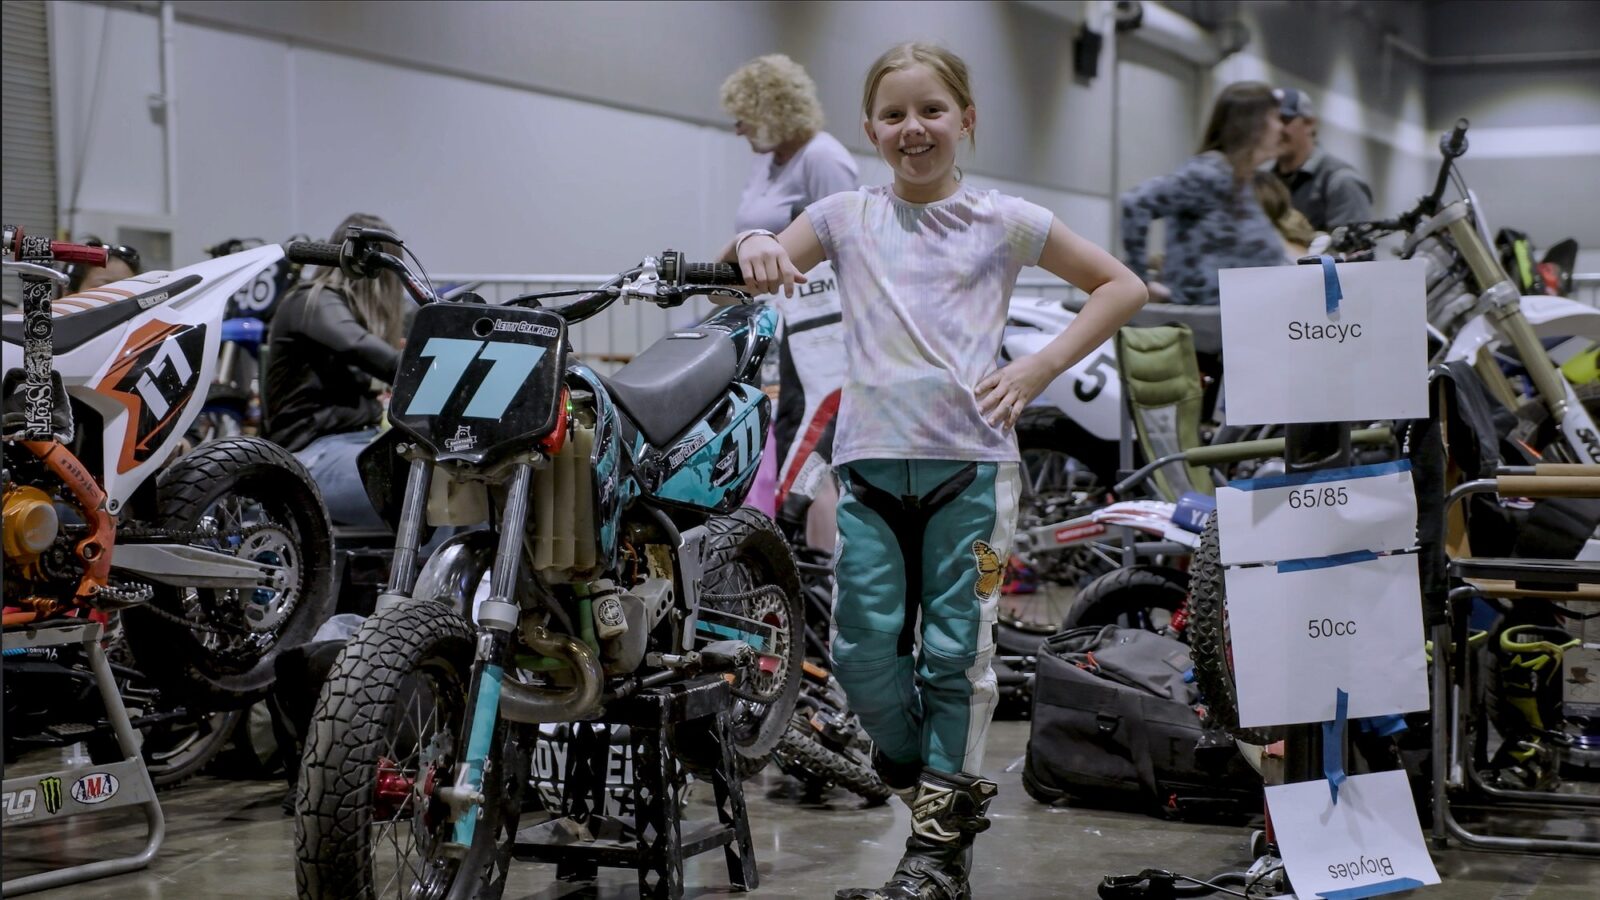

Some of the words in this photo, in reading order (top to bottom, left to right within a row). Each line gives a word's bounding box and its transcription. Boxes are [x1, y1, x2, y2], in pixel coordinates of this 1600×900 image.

[1288, 321, 1362, 343] Stacyc
[405, 337, 547, 419] 11
[1288, 486, 1348, 509] 65/85
[1308, 618, 1357, 639] 50cc
[76, 774, 113, 801] AMA
[1328, 855, 1395, 881] Bicycles
